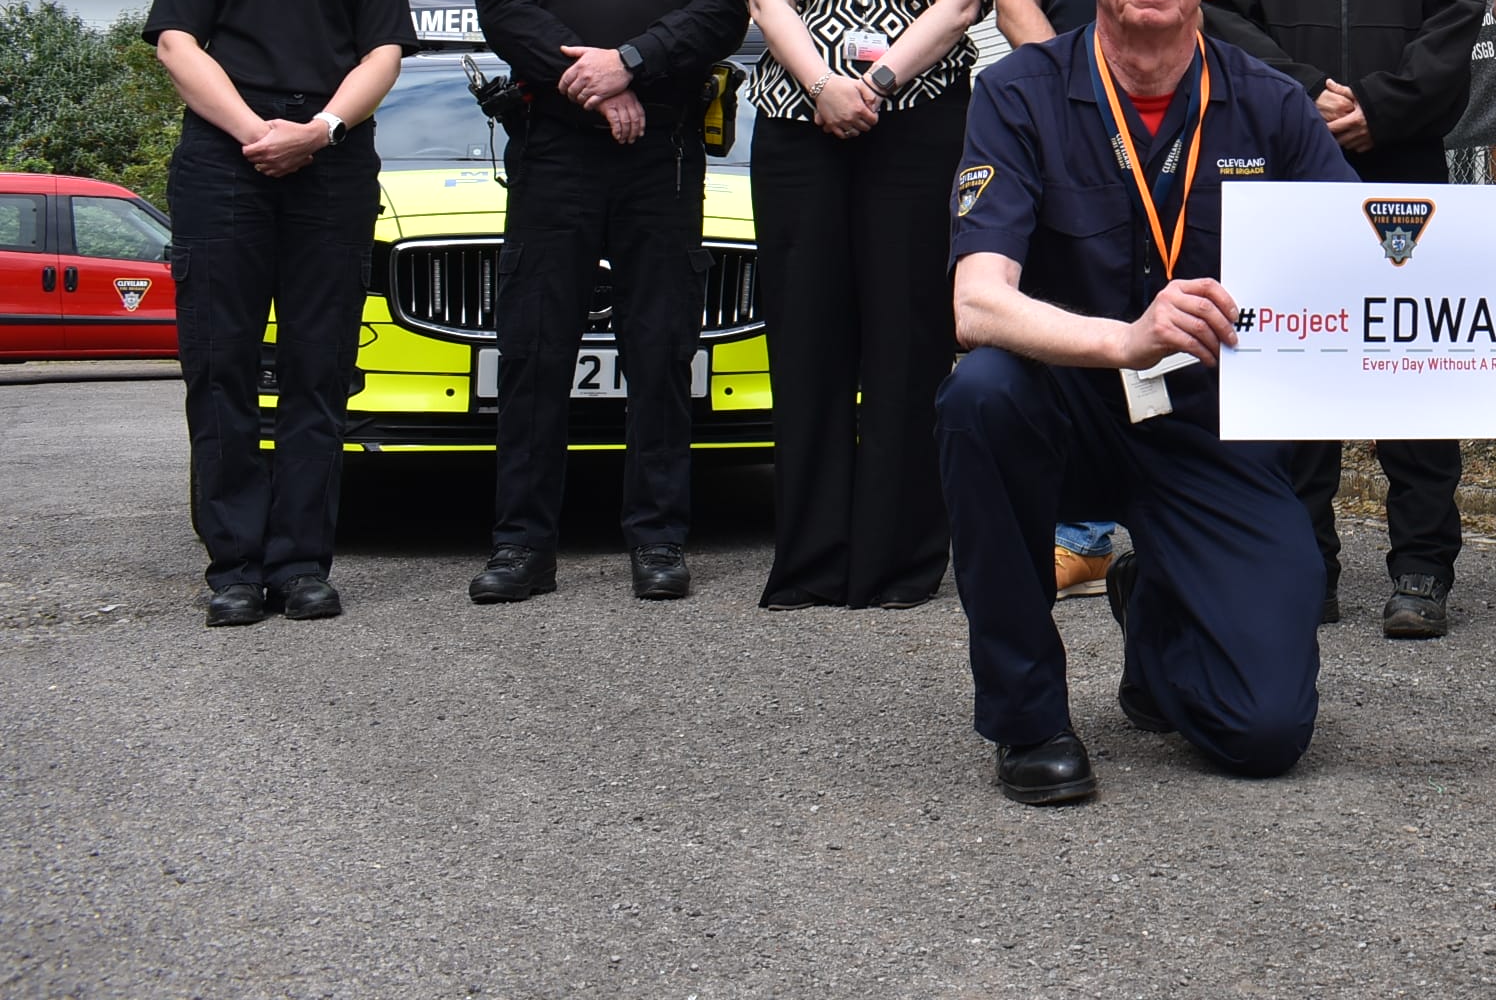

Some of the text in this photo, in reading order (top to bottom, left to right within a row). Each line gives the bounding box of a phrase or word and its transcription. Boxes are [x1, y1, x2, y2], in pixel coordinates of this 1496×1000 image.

[410, 8, 482, 33] MER
[1216, 157, 1266, 168] CLEVELAND
[1220, 167, 1235, 175] FIRE
[1370, 202, 1428, 216] CLEVELAND
[1374, 216, 1424, 225] FIRE BRIGADE
[1234, 307, 1349, 340] #Project
[1362, 357, 1399, 374] Every
[1402, 357, 1424, 374] Day
[1427, 357, 1477, 370] Without
[1479, 357, 1489, 370] A
